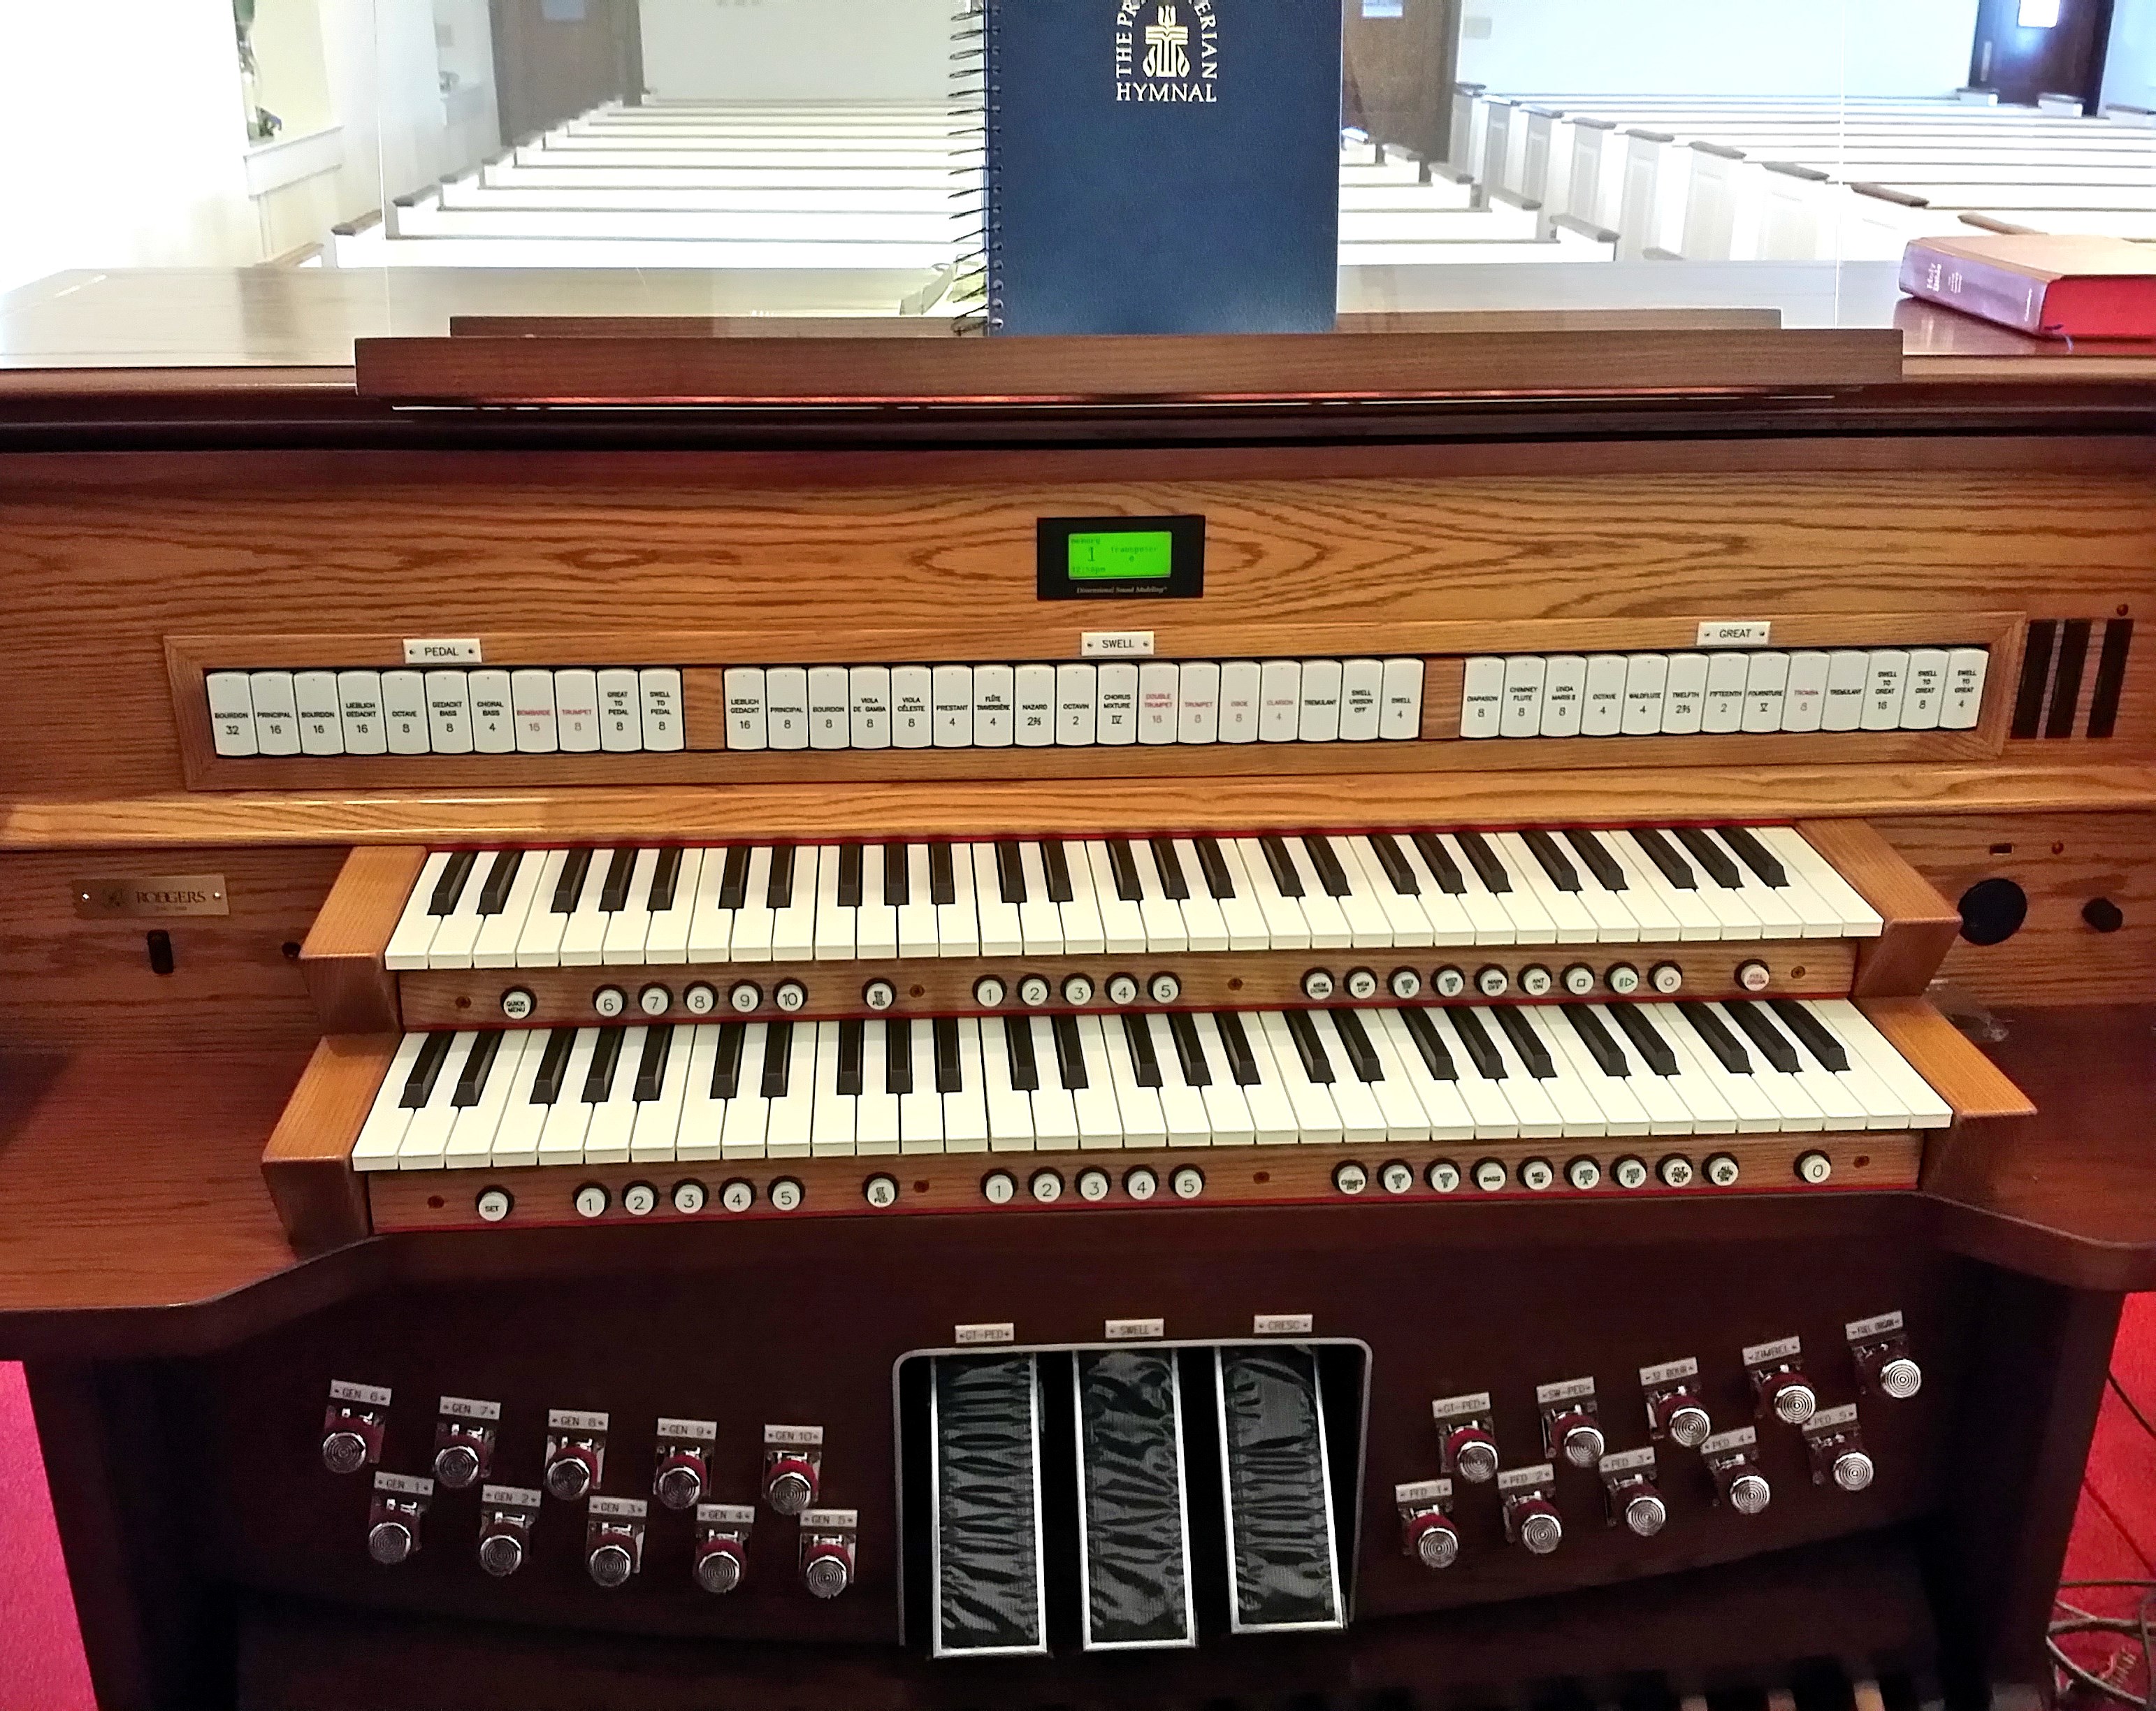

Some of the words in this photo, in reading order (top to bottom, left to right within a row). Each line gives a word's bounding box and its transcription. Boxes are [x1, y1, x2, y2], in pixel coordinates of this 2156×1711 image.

[1116, 33, 1133, 78] THE
[1117, 82, 1217, 103] HYMNAL
[1087, 547, 1095, 561] 1
[1719, 629, 1751, 638] GREAT
[1102, 640, 1134, 648] SWELL
[425, 647, 458, 656] PEDAL
[897, 704, 925, 712] CÉLESTE
[1721, 703, 1727, 712] 2
[1919, 700, 1926, 709] 8
[1478, 709, 1484, 717] 8
[1519, 708, 1525, 716] 8
[1559, 707, 1565, 716] 8
[1073, 716, 1079, 725] 2
[1112, 716, 1122, 724] IV
[1153, 715, 1162, 723] 16
[1194, 714, 1201, 723] 8
[447, 723, 454, 732] 8
[489, 723, 495, 731] 4
[529, 723, 540, 732] 16
[574, 723, 581, 731] 8
[616, 722, 623, 731] 8
[658, 722, 665, 730] 8
[740, 721, 750, 729] 16
[784, 720, 791, 729] 8
[825, 719, 832, 728] 8
[867, 719, 874, 728] 8
[909, 719, 916, 728] 8
[226, 725, 239, 735] 32
[270, 725, 282, 734] 16
[314, 725, 324, 733] 16
[357, 725, 368, 733] 16
[403, 724, 410, 733] 8
[137, 891, 205, 902] RODGERS
[986, 989, 992, 1000] 1
[1030, 988, 1040, 1000] 2
[1075, 987, 1084, 999] 3
[1118, 986, 1128, 998] 4
[1161, 985, 1171, 997] 5
[649, 997, 659, 1009] 7
[695, 996, 705, 1009] 8
[740, 995, 749, 1006] 9
[782, 993, 797, 1005] 10
[604, 999, 614, 1011] 6
[1043, 1183, 1052, 1197] 2
[1090, 1182, 1099, 1194] 3
[1137, 1181, 1145, 1194] 4
[1185, 1180, 1194, 1192] 5
[996, 1186, 1001, 1197] 1
[684, 1195, 694, 1208] 3
[732, 1194, 742, 1206] 4
[781, 1192, 791, 1205] 5
[587, 1199, 593, 1211] 1
[635, 1197, 644, 1210] 2
[1120, 1325, 1149, 1335] SWELL
[453, 1404, 470, 1414] GEN
[560, 1417, 579, 1425] GEN
[670, 1425, 688, 1434] GEN
[776, 1431, 794, 1440] GEN
[799, 1432, 812, 1441] 10
[1612, 1457, 1628, 1467] PED
[1638, 1455, 1643, 1464] 3
[386, 1480, 405, 1489] GEN
[1437, 1485, 1442, 1494] 1
[495, 1492, 512, 1502] GEN
[601, 1503, 619, 1512] GEN
[709, 1510, 726, 1519] GEN
